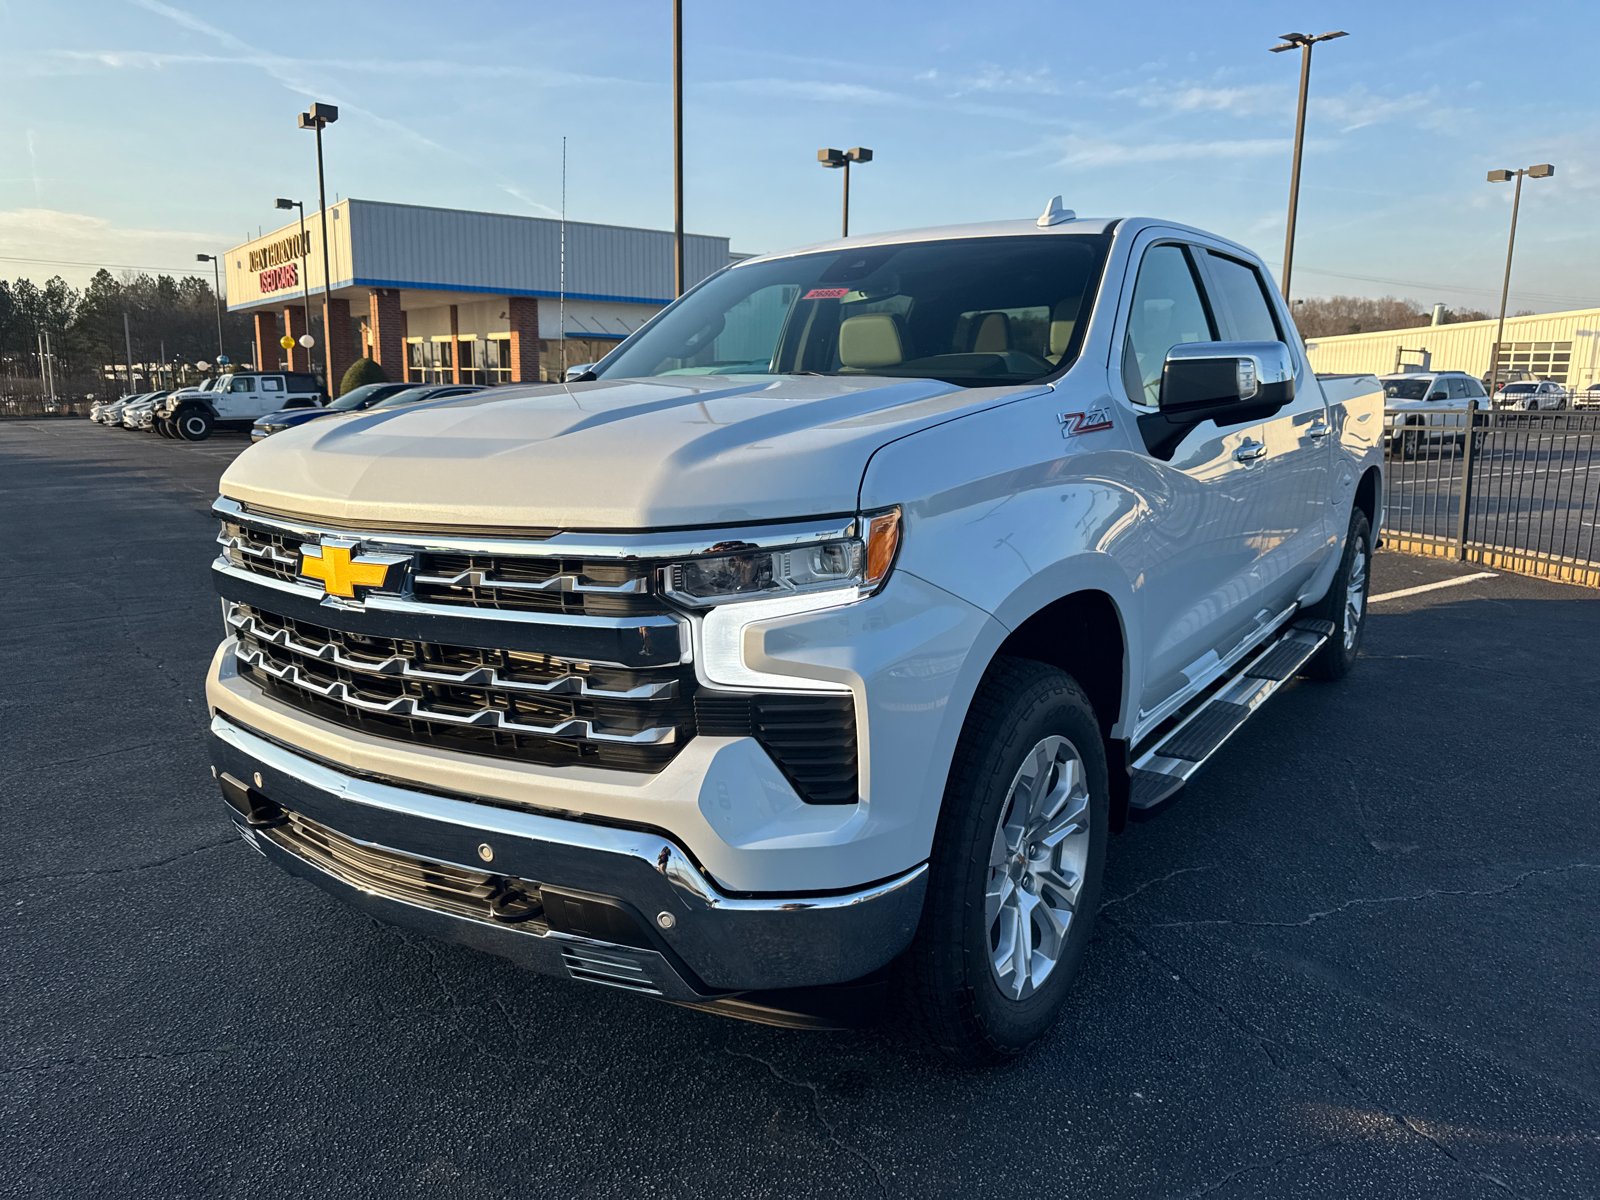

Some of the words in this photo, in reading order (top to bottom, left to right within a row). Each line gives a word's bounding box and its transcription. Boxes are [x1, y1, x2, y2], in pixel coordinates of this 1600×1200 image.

[259, 269, 277, 293] USED
[276, 263, 298, 289] CARS
[1057, 407, 1114, 439] Z71
